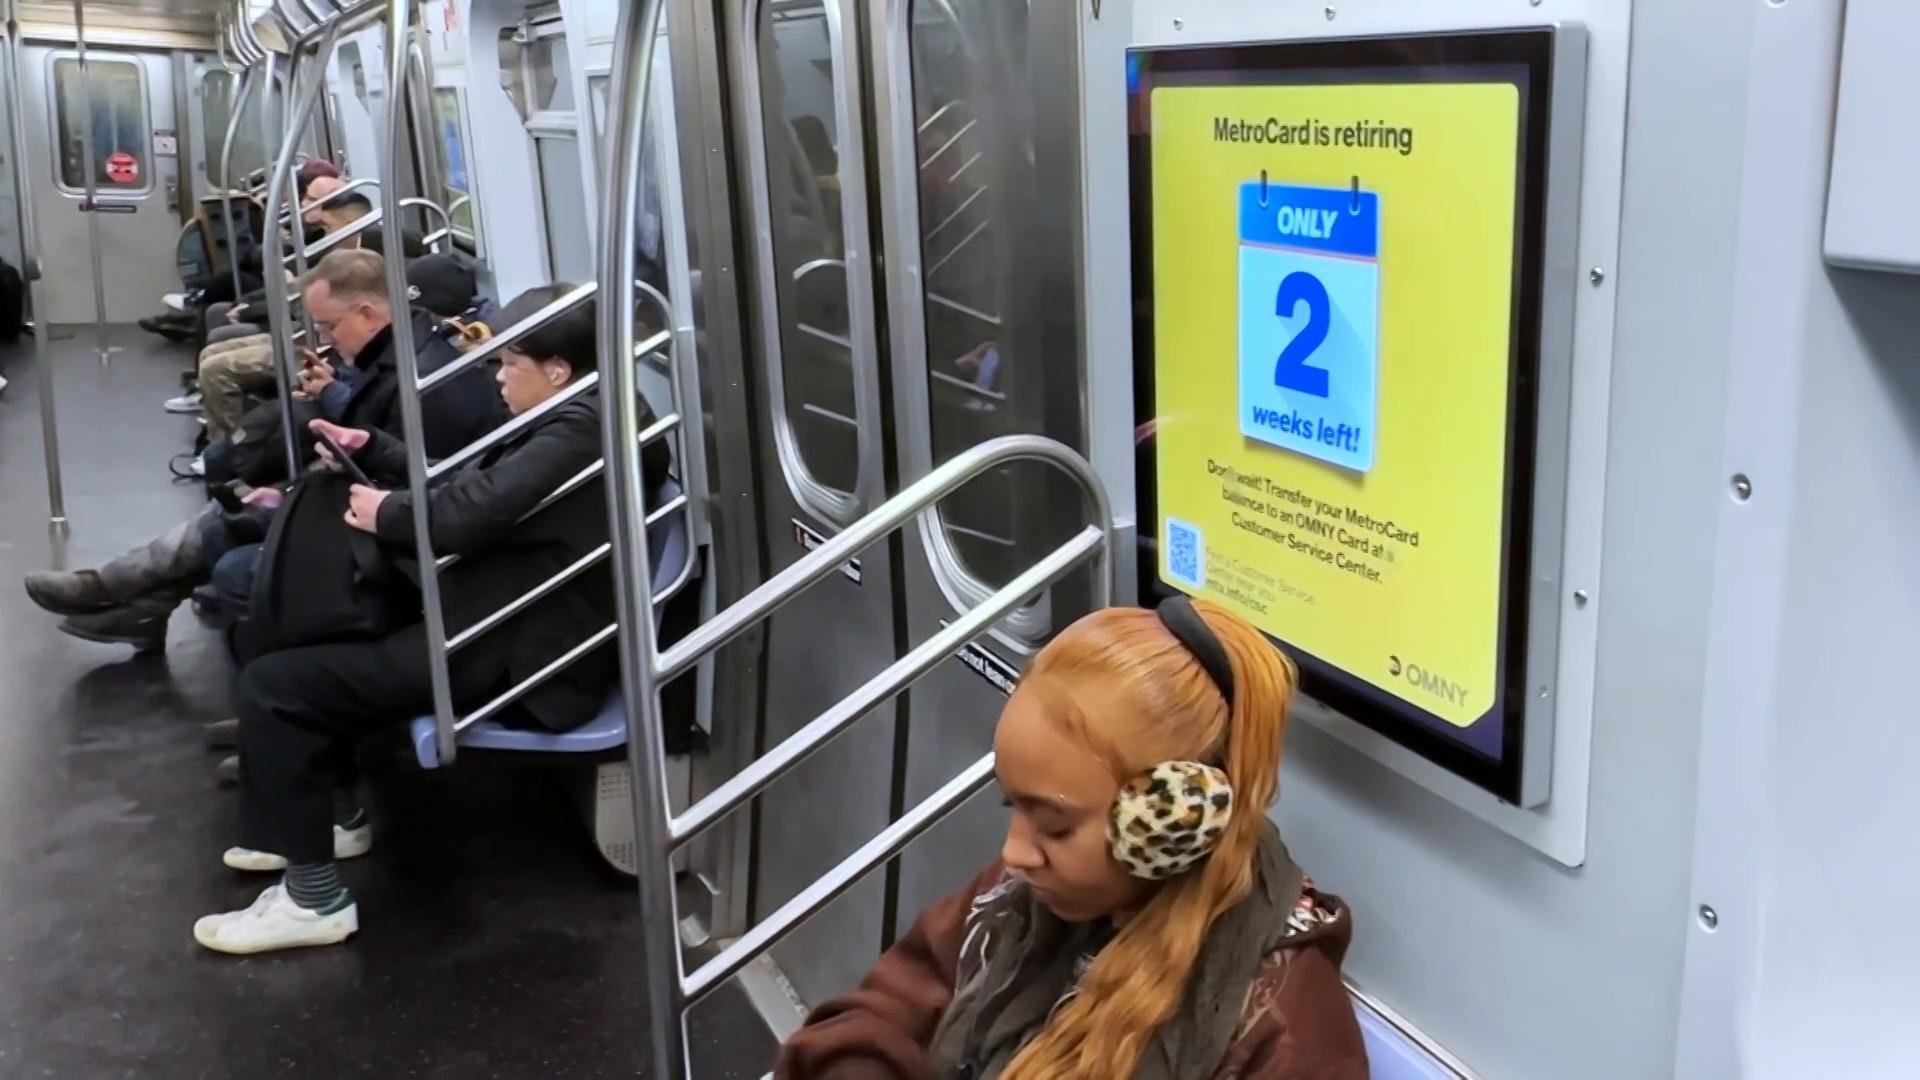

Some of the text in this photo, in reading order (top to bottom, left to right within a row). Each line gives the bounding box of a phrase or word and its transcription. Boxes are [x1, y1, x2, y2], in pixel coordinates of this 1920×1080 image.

[1214, 117, 1413, 156] MetroCard is retiring
[1277, 205, 1339, 239] ONLY
[1275, 271, 1330, 398] 2
[1252, 405, 1361, 453] weeks left!
[1222, 484, 1265, 514] bnce
[1265, 503, 1278, 518] to
[1279, 511, 1294, 525] an
[1296, 513, 1336, 540] OMNY
[1337, 528, 1369, 554] Card
[1371, 543, 1384, 558] at
[1264, 477, 1313, 508] Transfer
[1314, 499, 1342, 519] your
[1345, 507, 1419, 548] MetroCard
[1231, 511, 1384, 586] Customer Service Center.
[1406, 663, 1469, 707] OMNY
